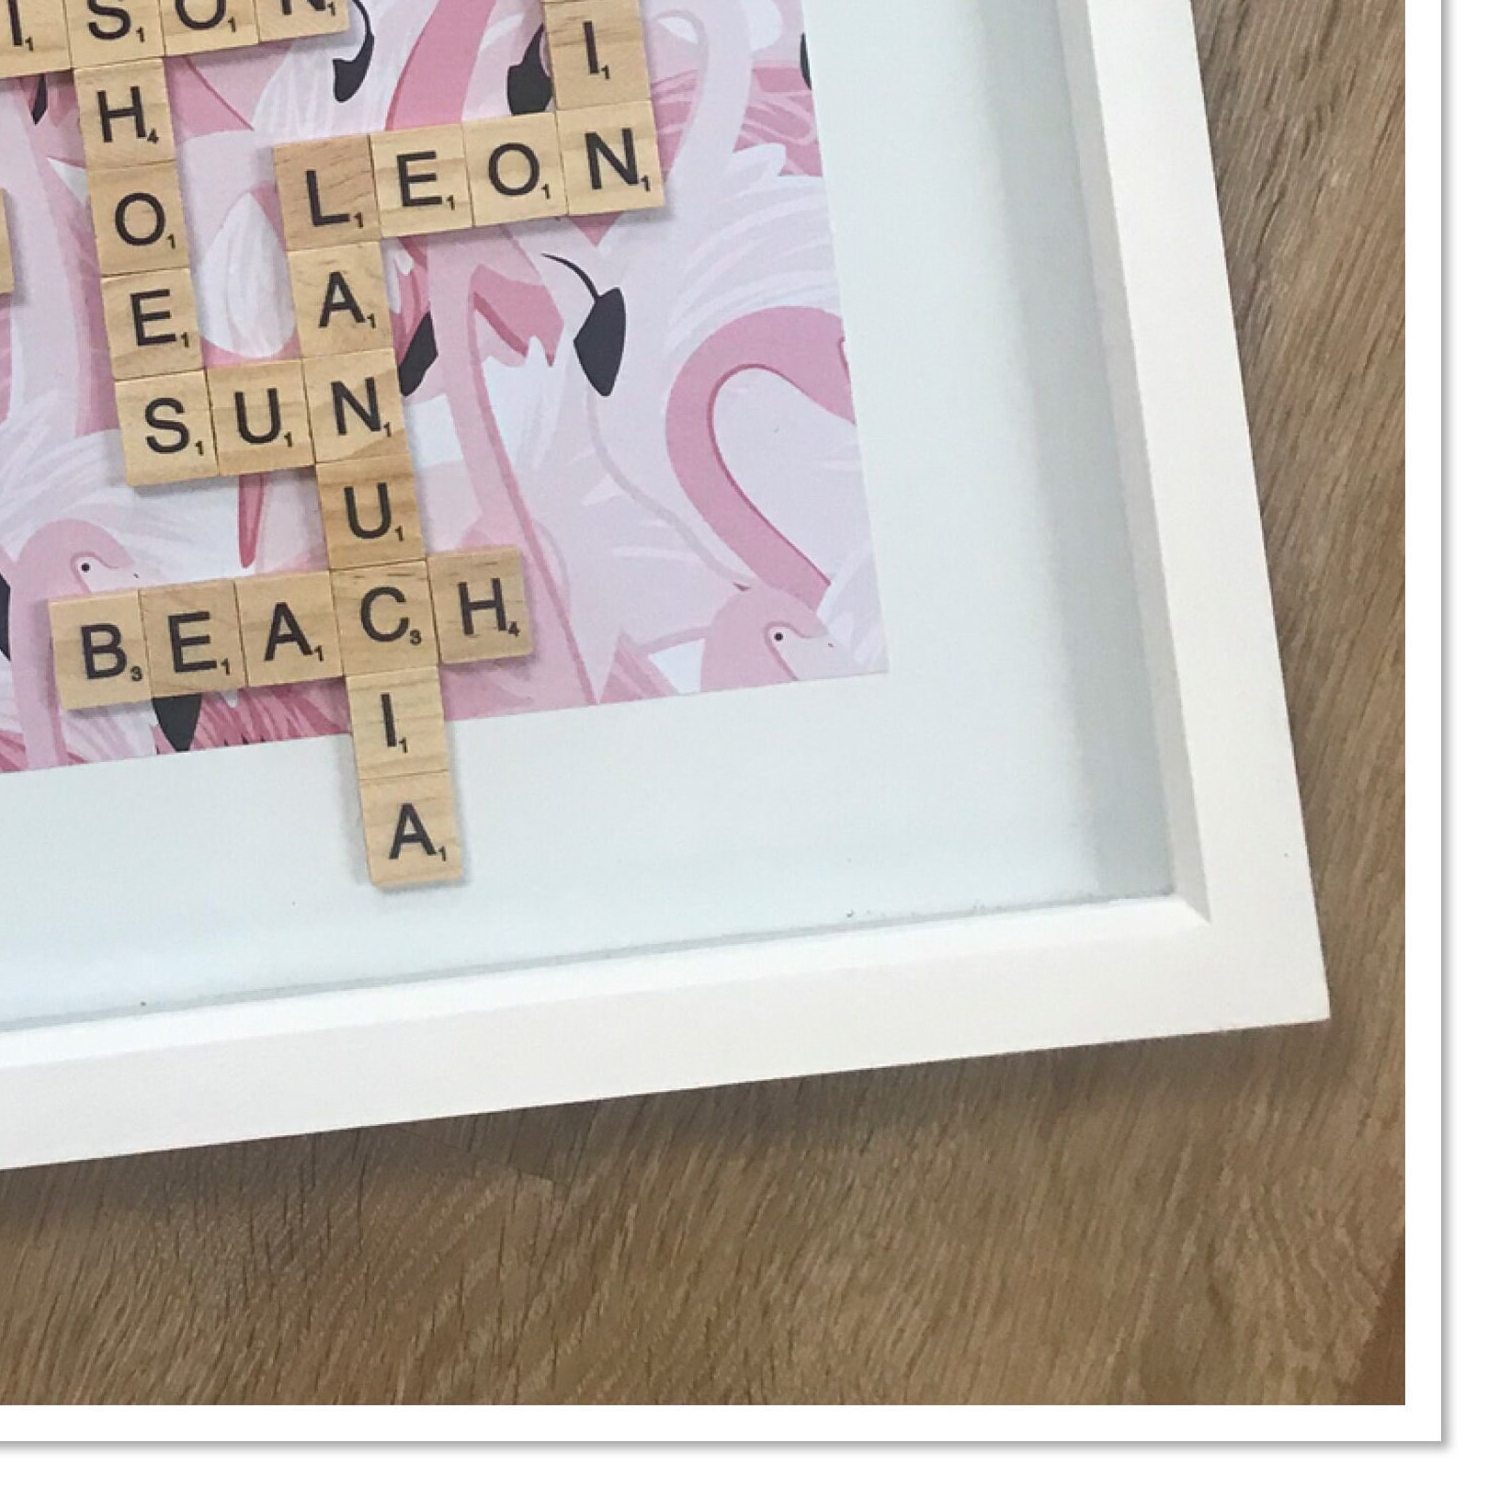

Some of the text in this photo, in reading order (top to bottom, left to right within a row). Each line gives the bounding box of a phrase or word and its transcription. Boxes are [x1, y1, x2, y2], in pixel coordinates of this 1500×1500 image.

[304, 126, 641, 229] LEON
[143, 375, 383, 456] SUN
[304, 168, 438, 862] LANUCIA
[79, 576, 509, 681] BEACH
